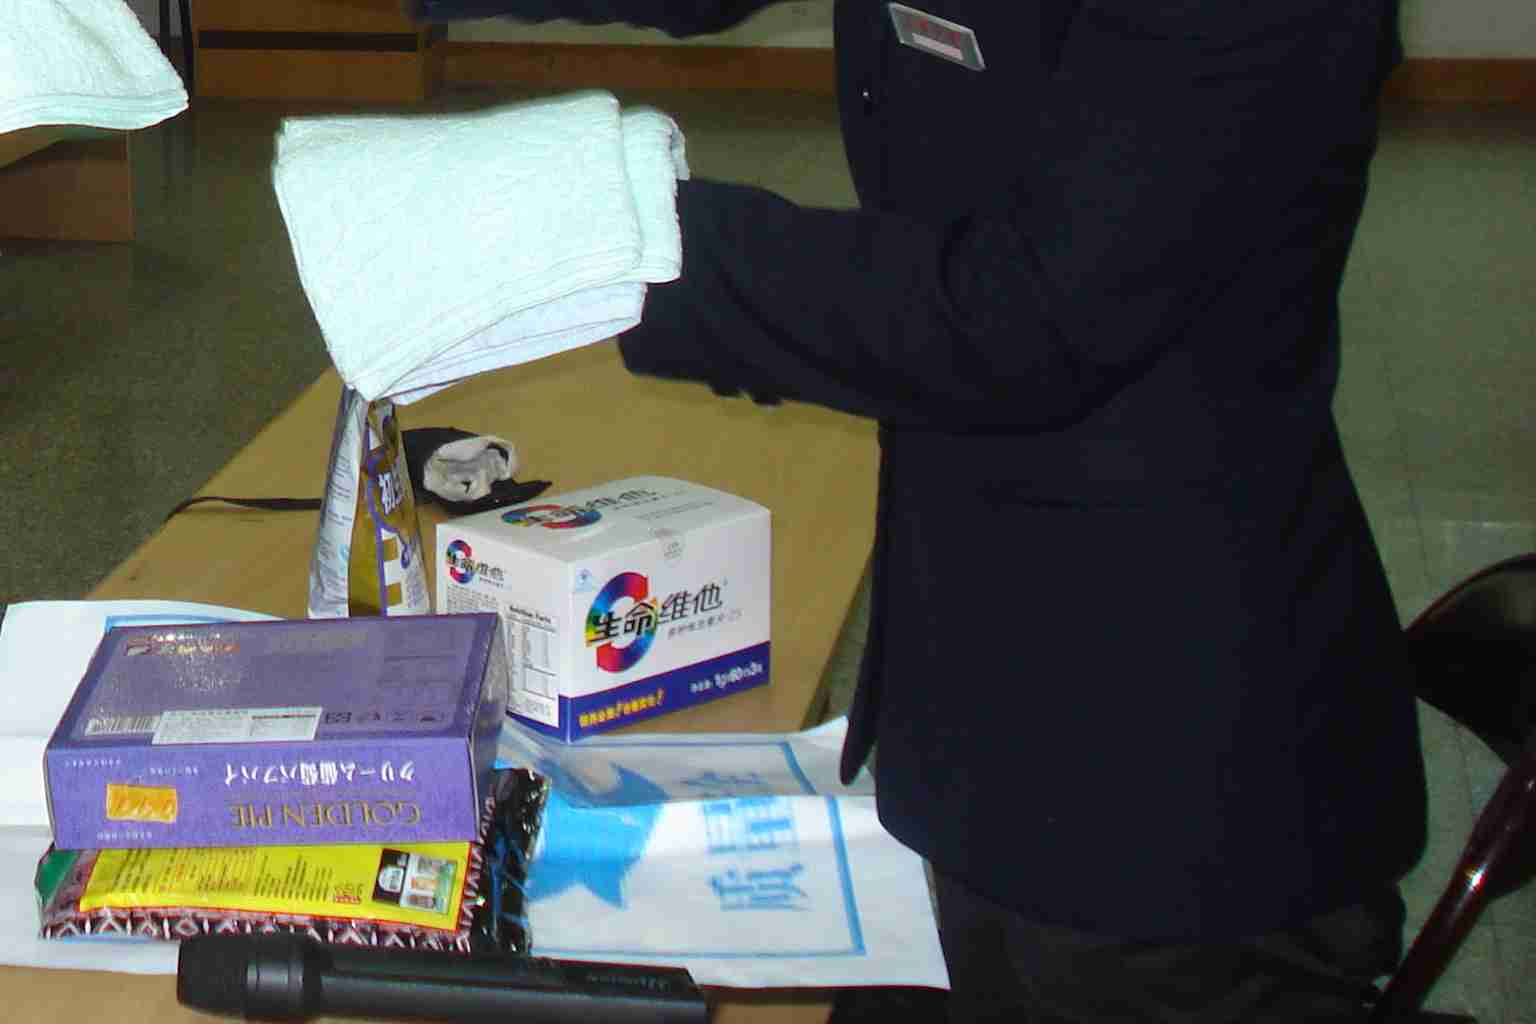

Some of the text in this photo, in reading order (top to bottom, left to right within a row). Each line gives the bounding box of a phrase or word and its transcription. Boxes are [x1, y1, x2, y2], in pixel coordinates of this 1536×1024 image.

[589, 582, 723, 642] 生命维他
[230, 800, 422, 830] GOLDEN PIE
